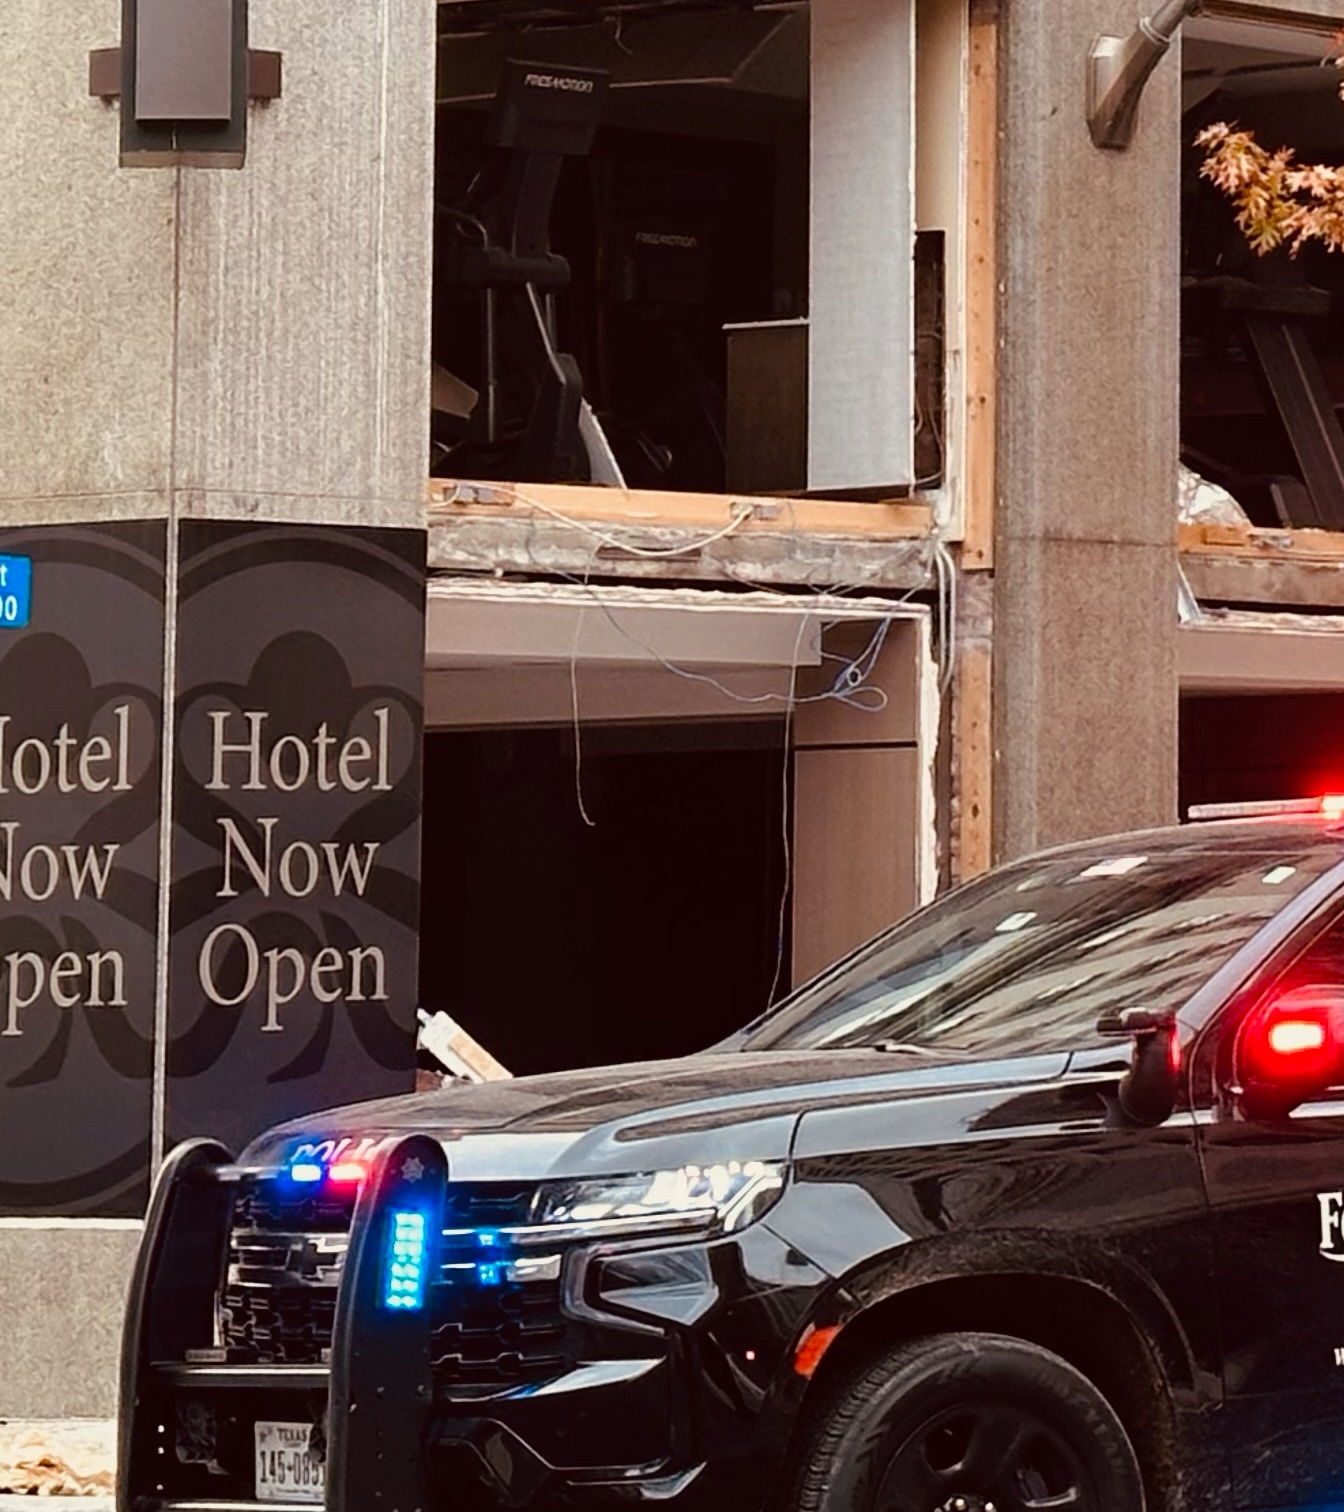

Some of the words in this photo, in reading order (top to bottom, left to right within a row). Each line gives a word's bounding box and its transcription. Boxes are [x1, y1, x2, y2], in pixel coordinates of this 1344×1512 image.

[0, 706, 133, 794] otel
[205, 707, 393, 792] Hotel
[215, 817, 380, 899] Now
[199, 922, 388, 1032] Open
